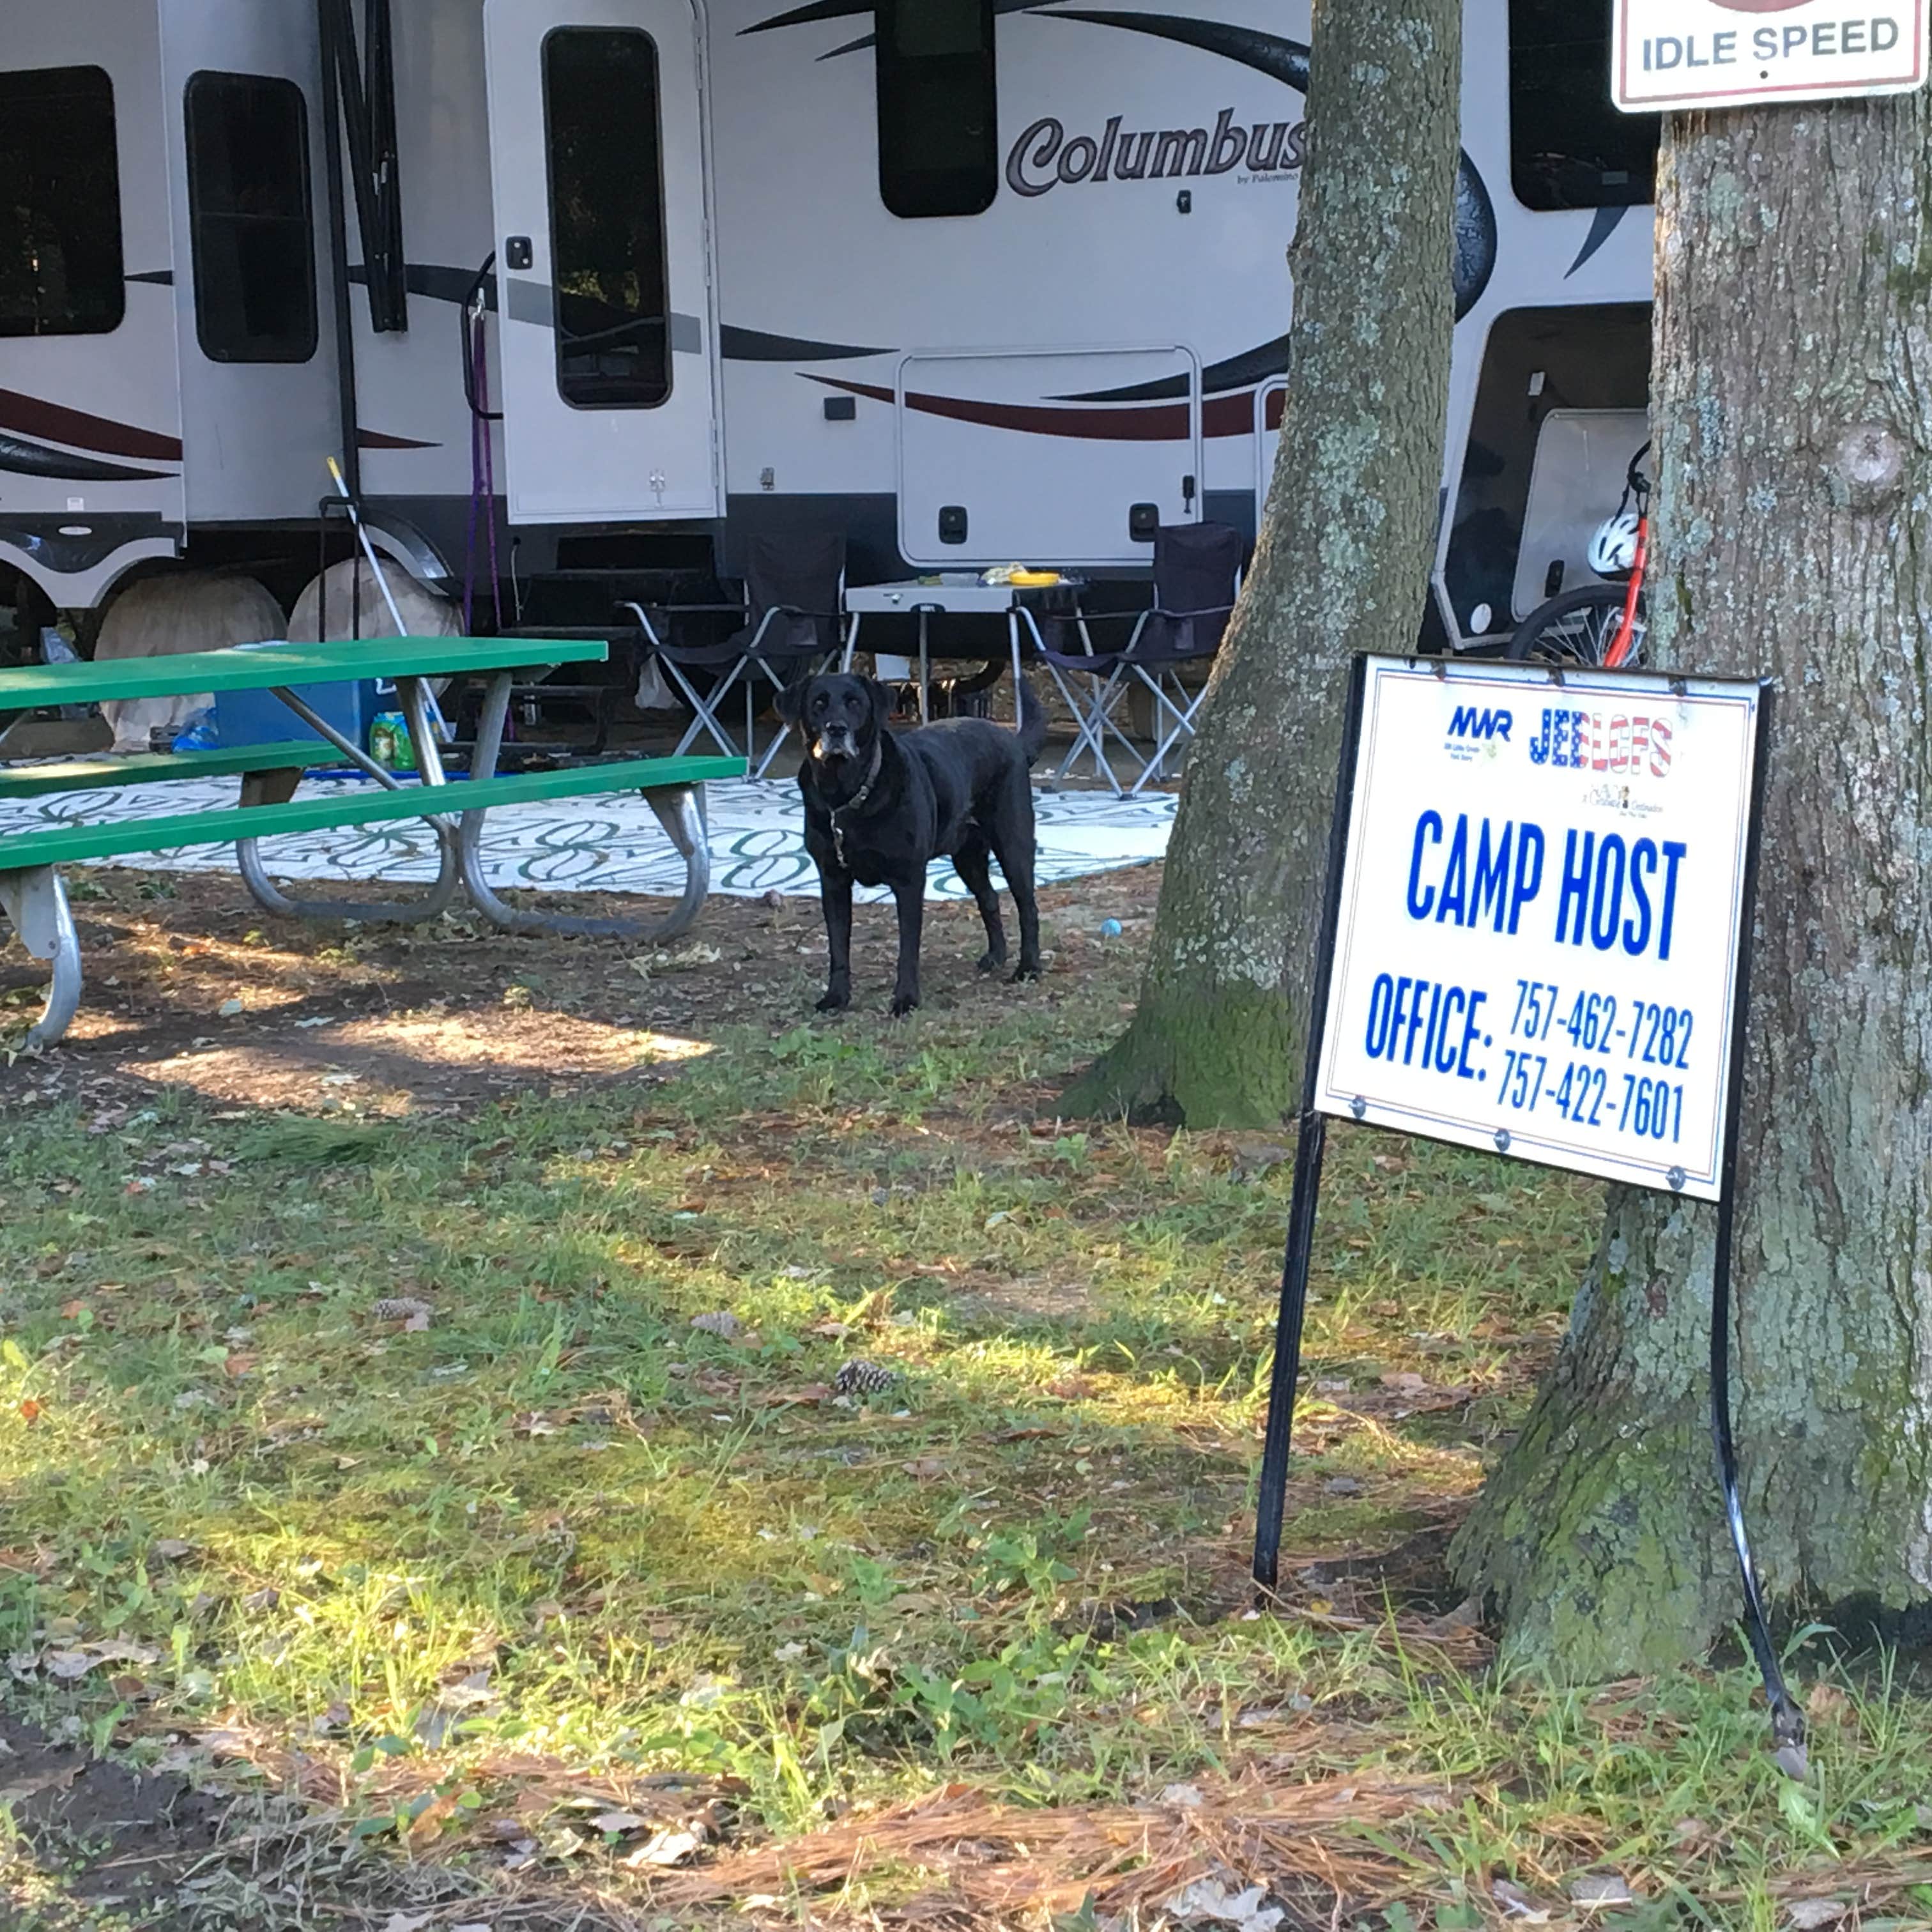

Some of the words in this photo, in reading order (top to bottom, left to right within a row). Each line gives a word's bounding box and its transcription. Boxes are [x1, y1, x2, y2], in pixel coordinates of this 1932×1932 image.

[1643, 31, 1738, 71] IDLE
[1753, 17, 1899, 61] SPEED
[1006, 107, 1306, 197] Columbus
[1237, 176, 1248, 186] by
[1447, 705, 1514, 742] MWR
[1406, 809, 1545, 935] CAMP
[1554, 828, 1687, 961] HOST
[1365, 972, 1493, 1082] OFFICE:
[1510, 979, 1694, 1070] 757-462-7282
[1497, 1050, 1684, 1144] 757-422-7601
